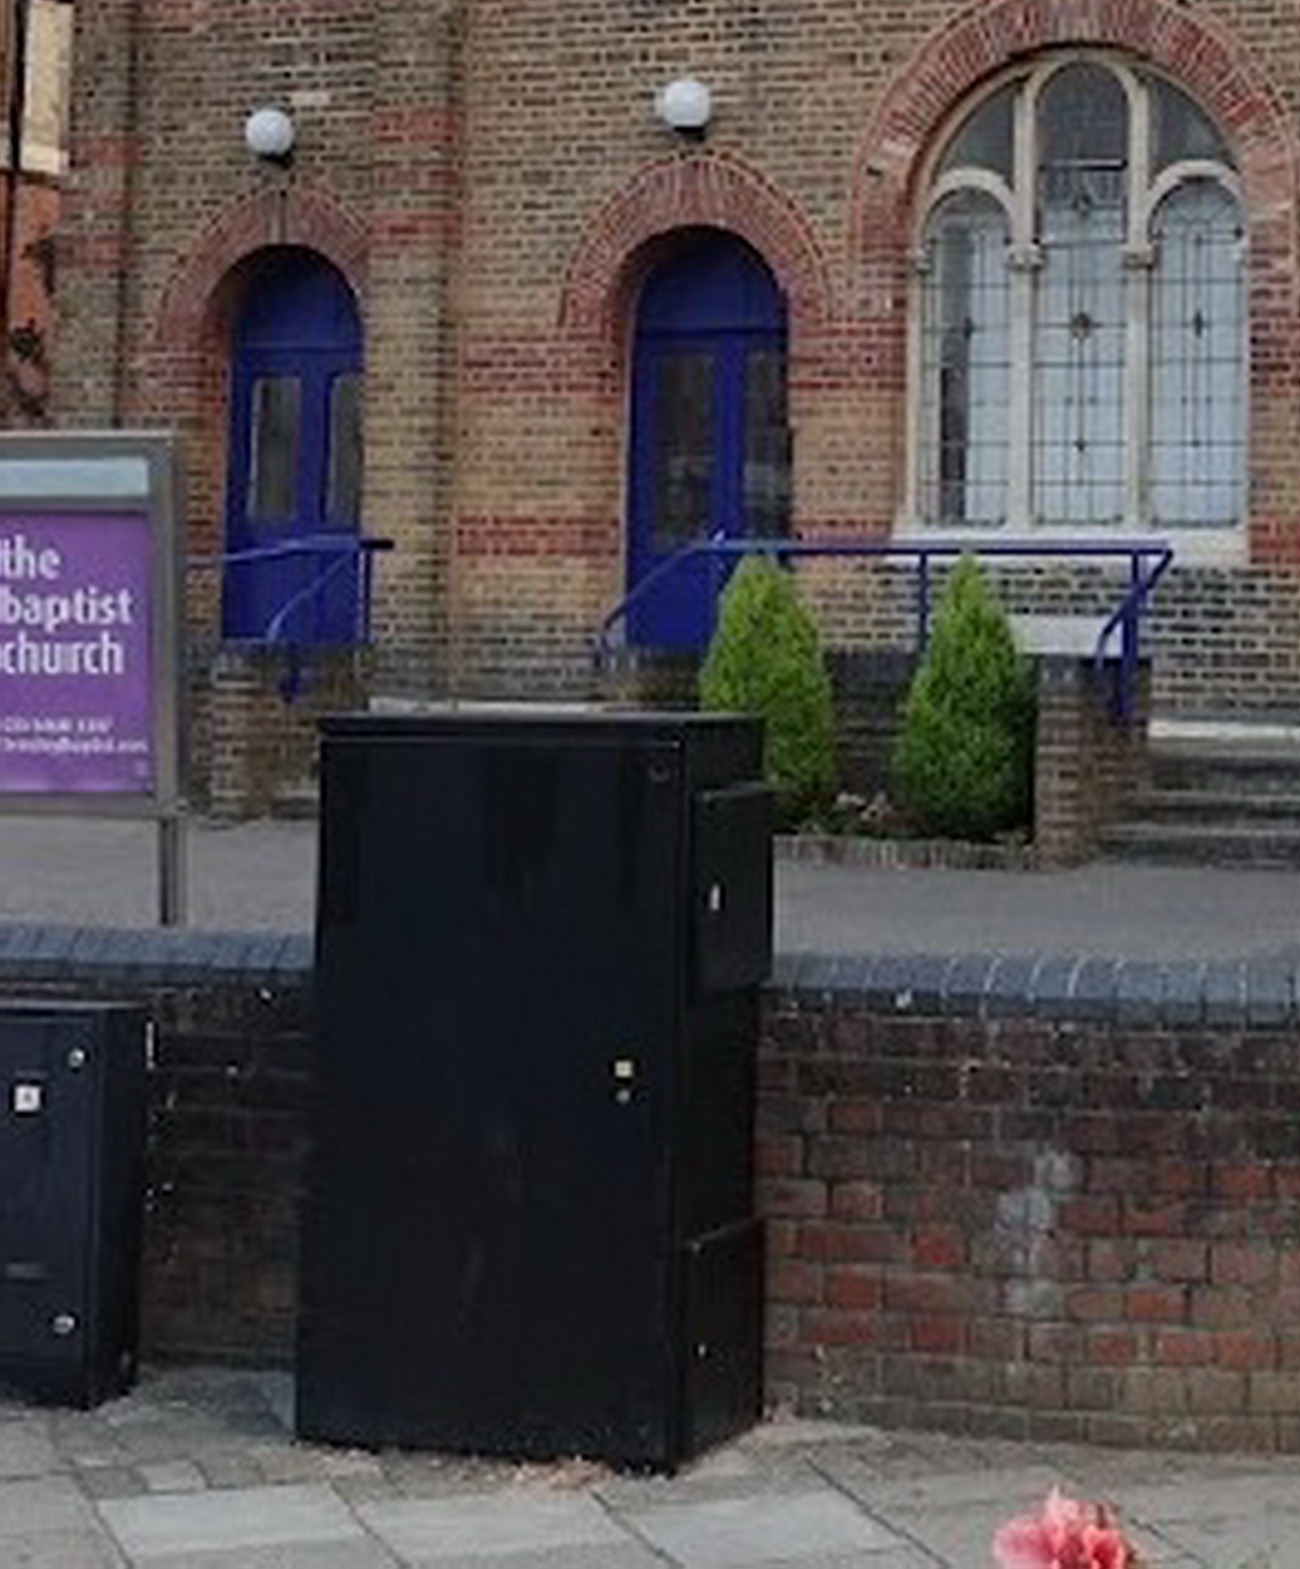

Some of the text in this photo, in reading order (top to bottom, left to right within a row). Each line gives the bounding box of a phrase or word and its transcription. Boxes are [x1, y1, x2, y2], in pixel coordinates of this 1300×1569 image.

[0, 535, 60, 579] the
[0, 585, 133, 633] baptist
[0, 631, 123, 674] church
